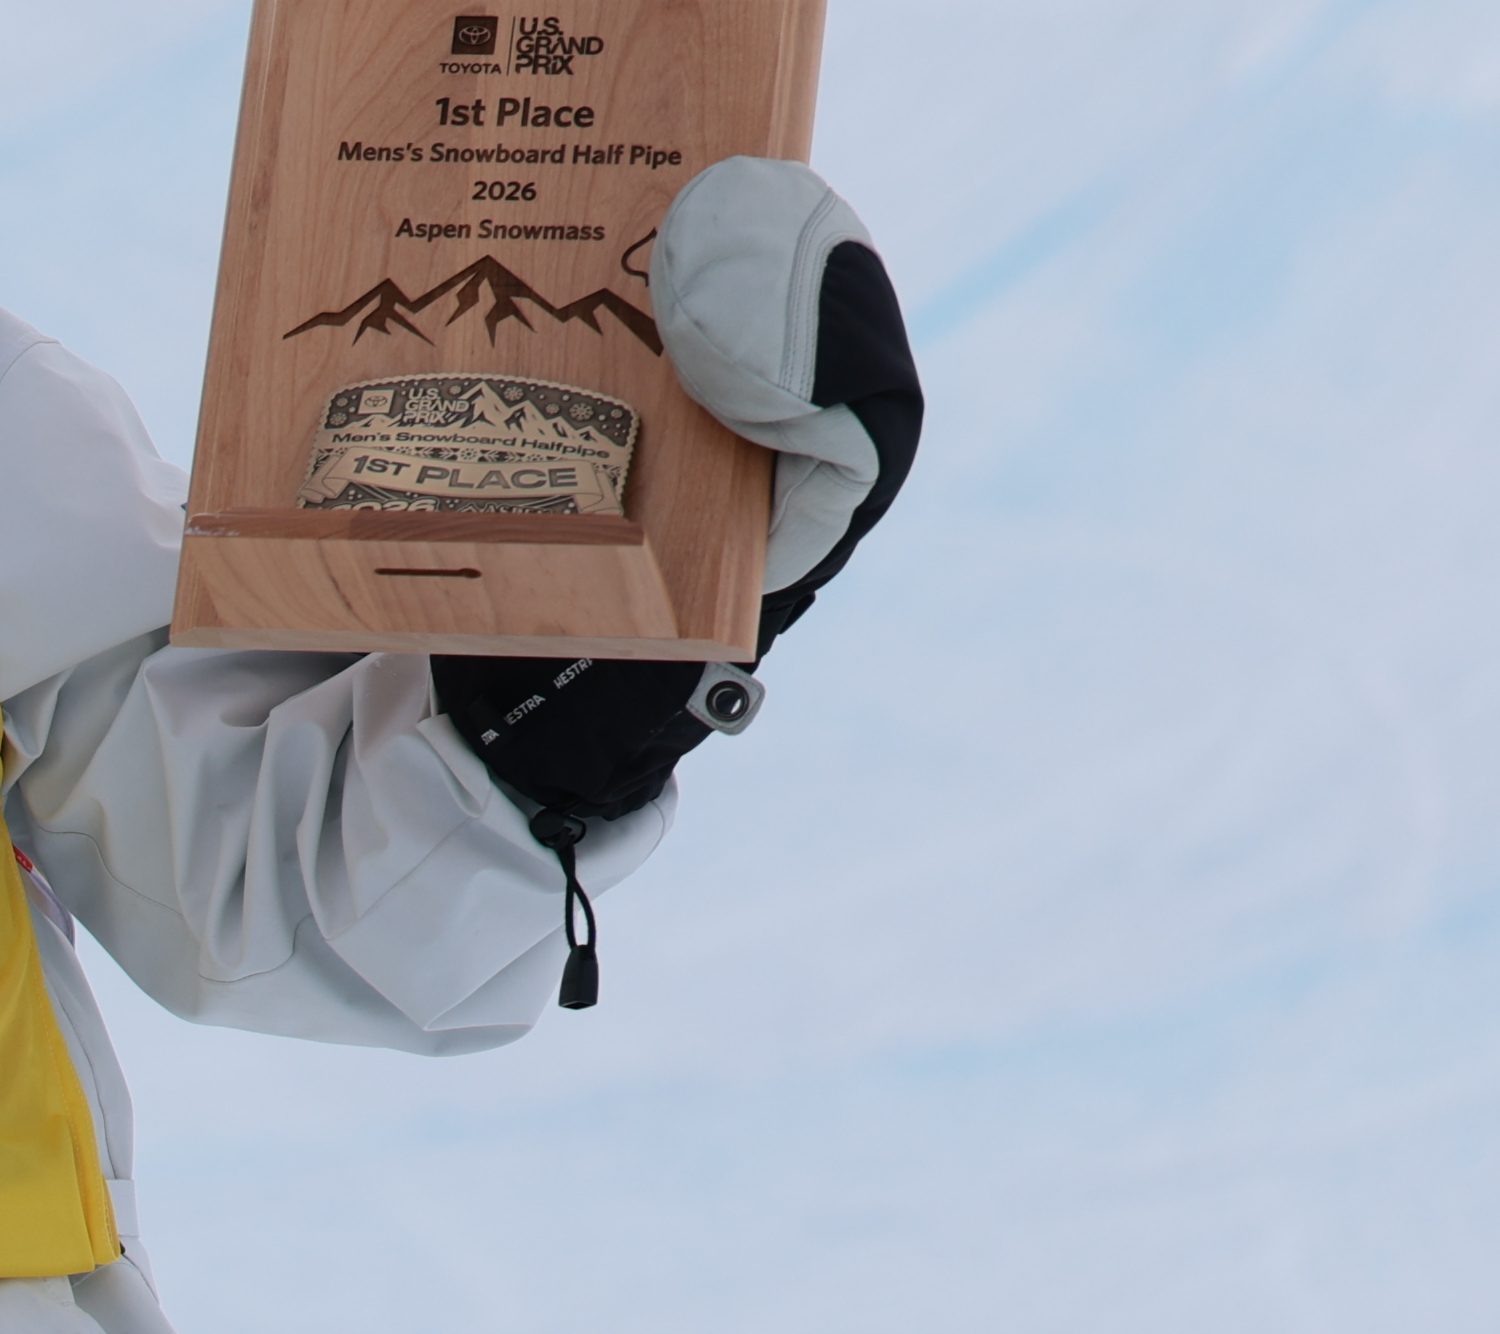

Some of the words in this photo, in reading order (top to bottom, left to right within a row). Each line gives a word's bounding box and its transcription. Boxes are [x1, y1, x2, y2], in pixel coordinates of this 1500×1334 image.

[520, 17, 563, 35] U.S.
[516, 36, 604, 55] GRAND
[440, 63, 502, 74] TOYOTA
[515, 55, 574, 75] PRIX
[435, 97, 485, 126] 1st
[497, 97, 594, 127] Place
[338, 141, 422, 162] Mens's
[430, 143, 564, 165] Snowboard
[572, 145, 623, 164] Half
[630, 146, 682, 169] Pipe
[472, 181, 537, 201] 2026
[395, 218, 471, 243] Aspen
[478, 219, 605, 241] Snowmass
[409, 388, 438, 400] U.S.
[405, 399, 470, 413] GRAND
[401, 411, 447, 424] PRIX
[332, 432, 390, 444] Men's
[396, 432, 517, 447] Snowboard
[521, 438, 610, 459] Halfpipe
[353, 455, 411, 475] 1ST
[416, 465, 578, 489] PLACE
